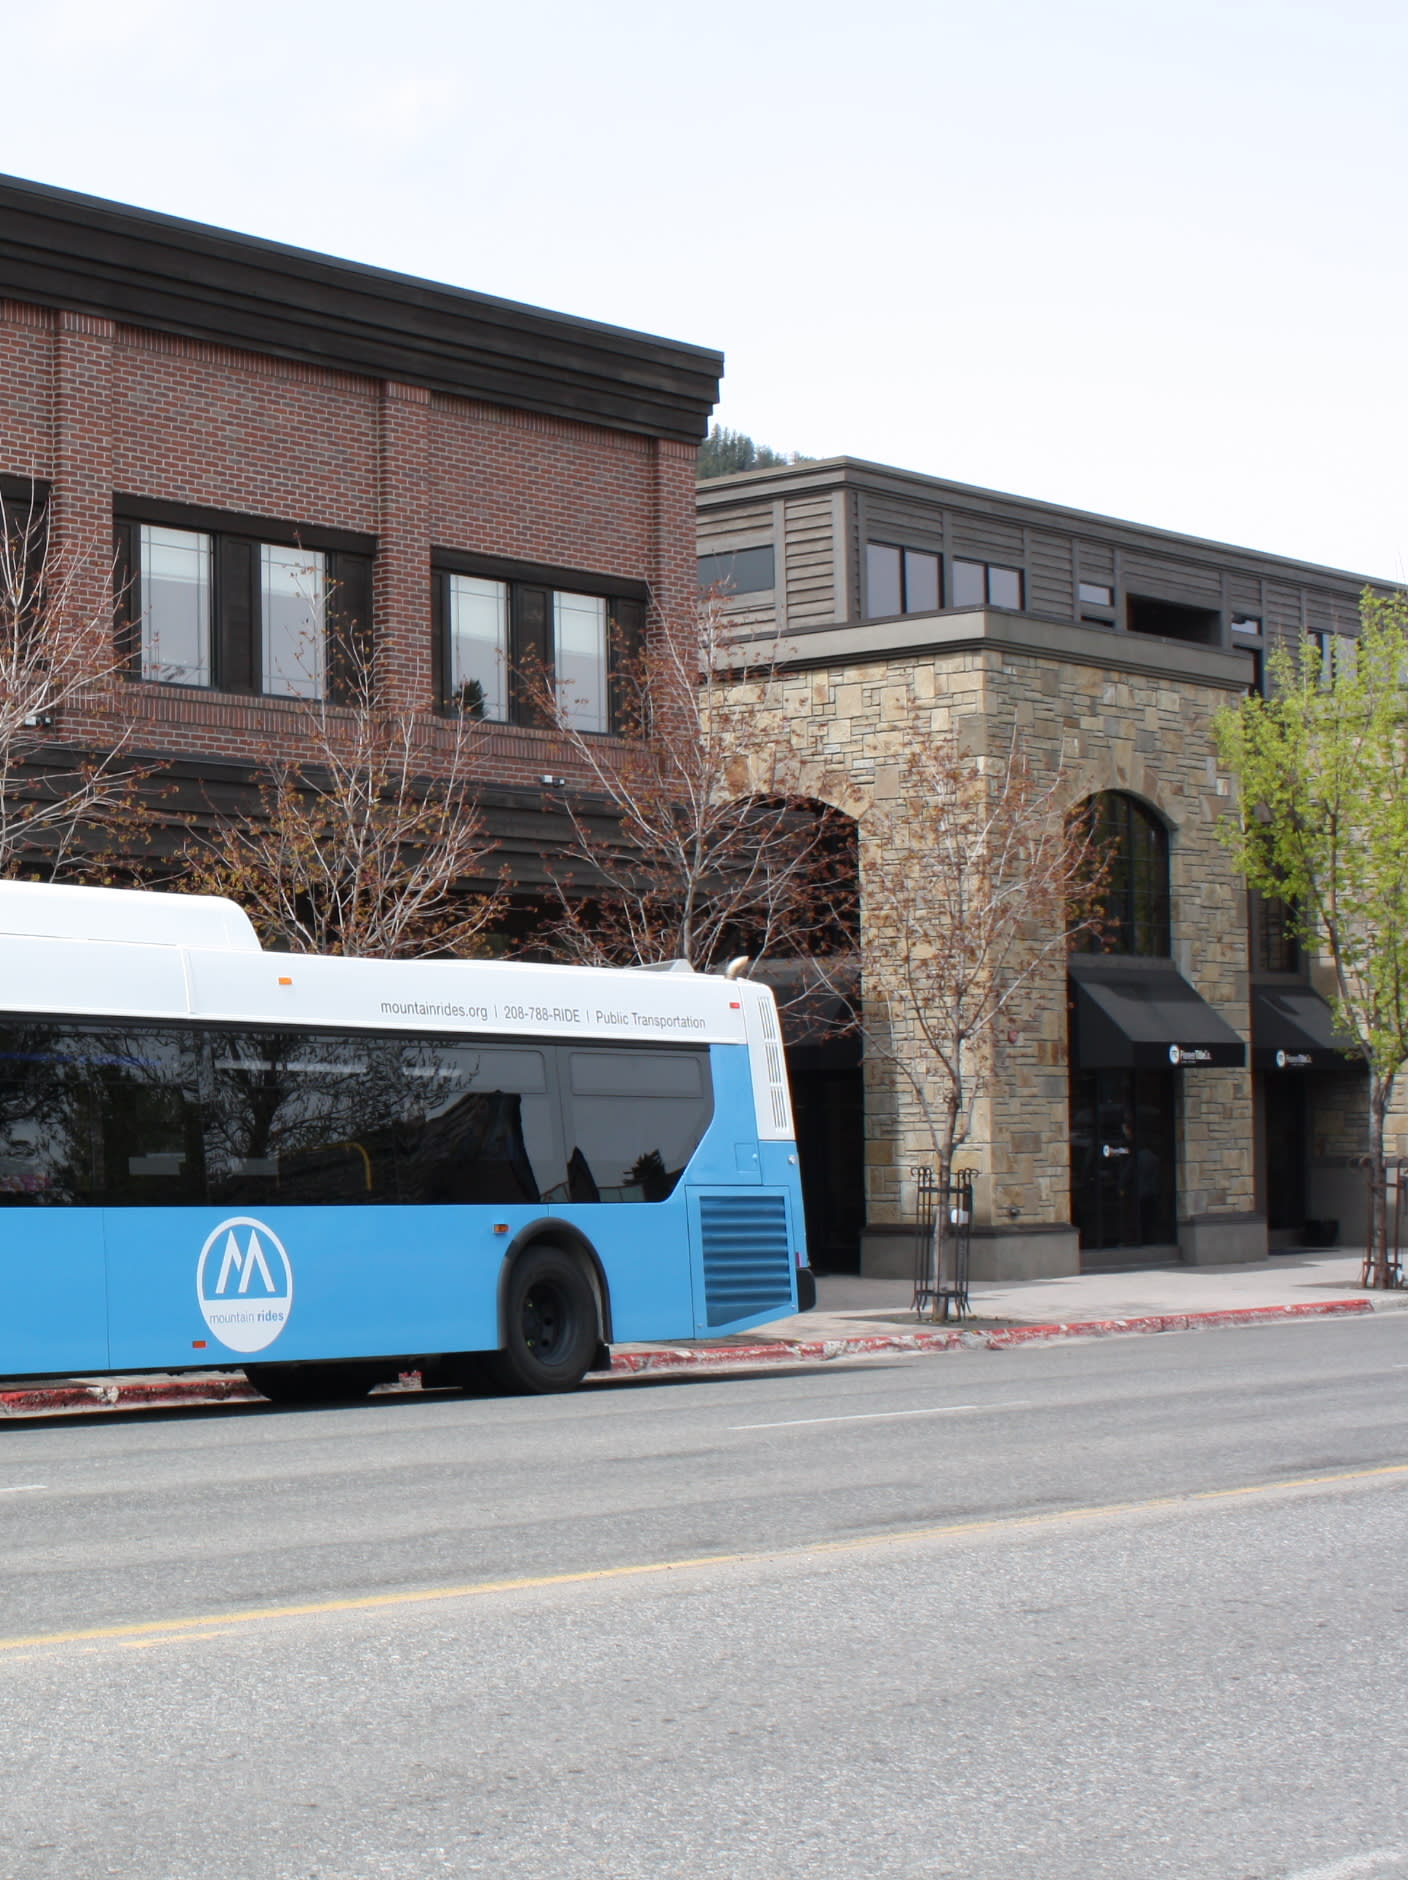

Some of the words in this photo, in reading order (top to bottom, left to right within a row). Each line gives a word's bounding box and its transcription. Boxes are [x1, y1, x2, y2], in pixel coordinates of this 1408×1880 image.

[380, 1000, 488, 1021] mountainrides.org
[503, 1005, 581, 1023] 208-788-RIDE
[595, 1010, 629, 1026] Public
[631, 1012, 706, 1030] Transportation
[209, 1311, 255, 1325] mountain
[257, 1309, 285, 1323] rides
